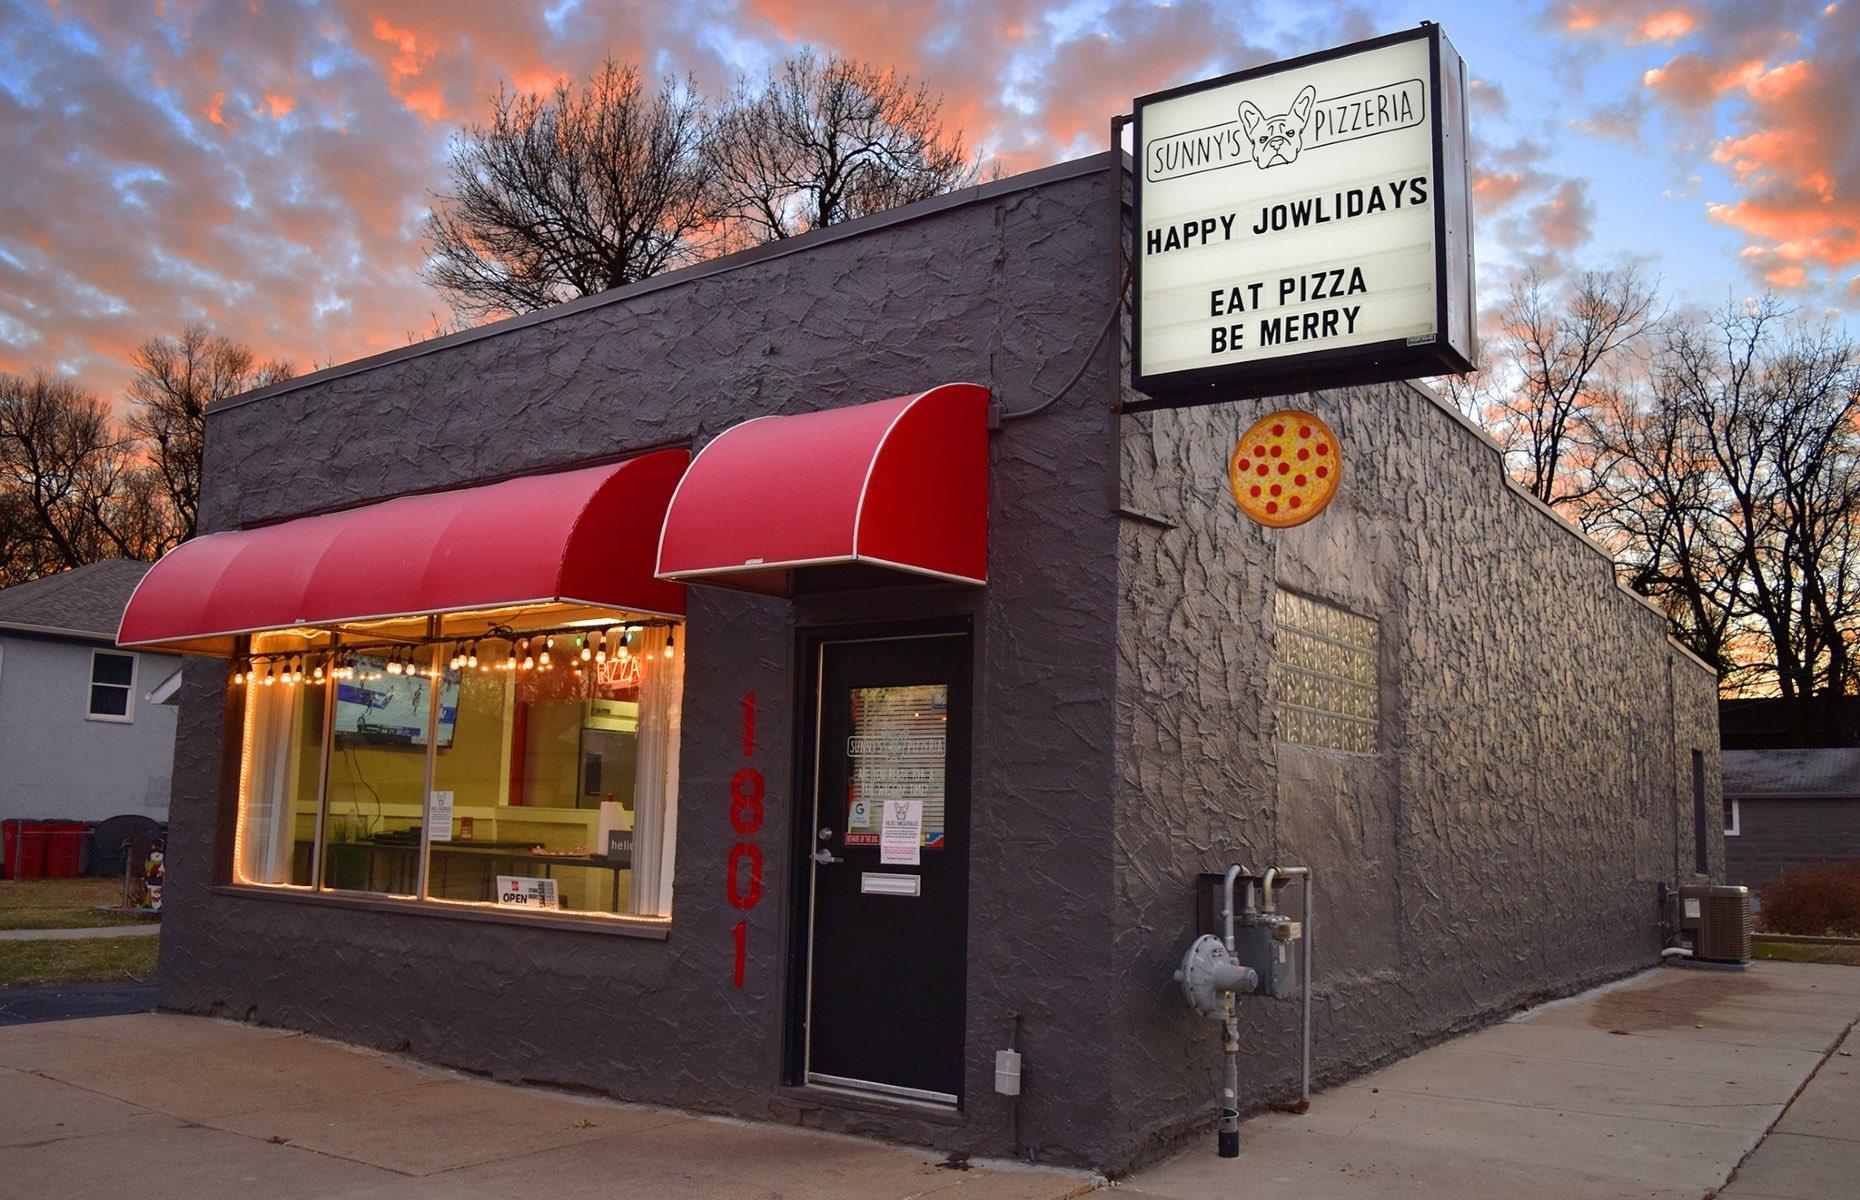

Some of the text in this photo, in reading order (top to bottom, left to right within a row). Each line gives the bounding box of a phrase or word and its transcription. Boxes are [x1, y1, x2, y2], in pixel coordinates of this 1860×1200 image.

[1153, 90, 1414, 174] SUNNY'S PIZZERIA
[1147, 176, 1428, 256] HAPPY JOWLIDAYS
[1210, 267, 1367, 317] EAT PIZZA
[1211, 306, 1361, 354] BE MERRY
[597, 656, 640, 685] PIZZA
[503, 892, 528, 904] OPEN
